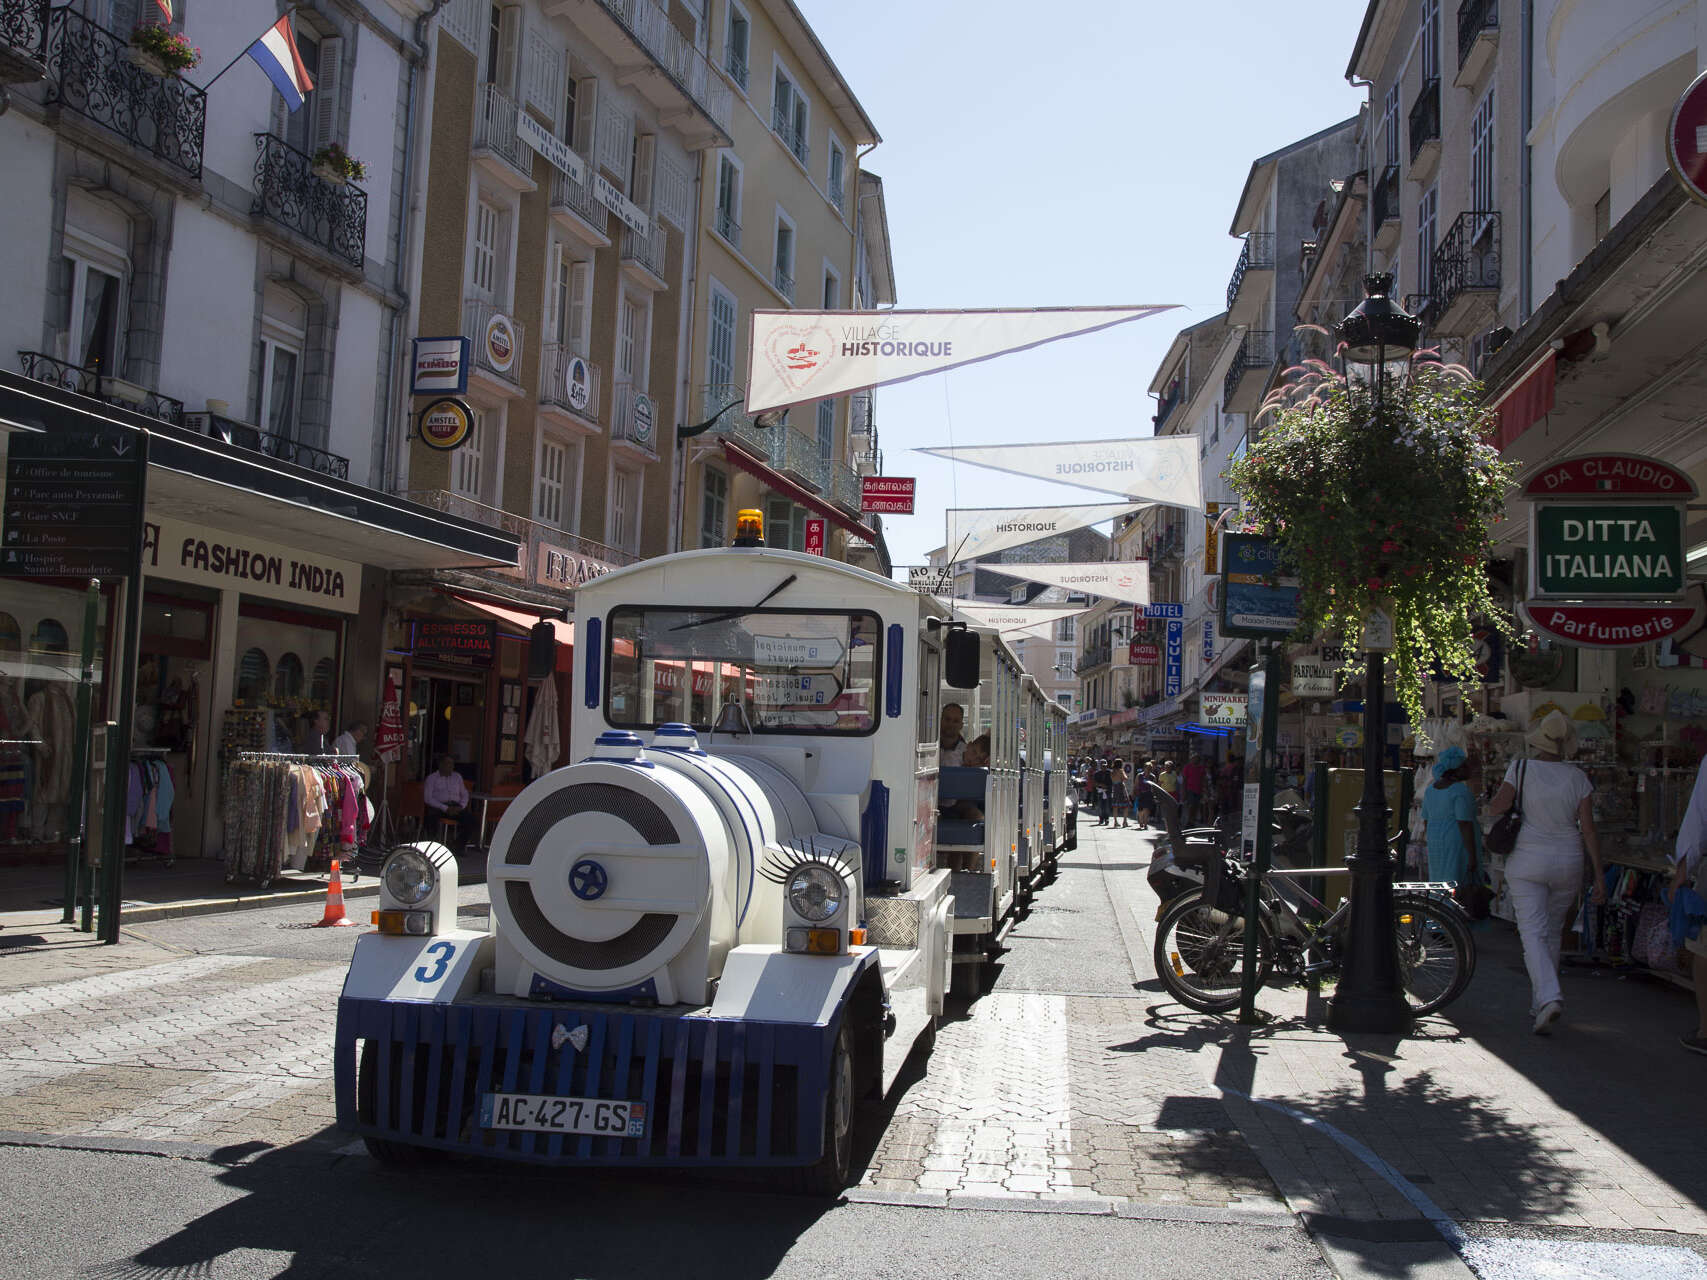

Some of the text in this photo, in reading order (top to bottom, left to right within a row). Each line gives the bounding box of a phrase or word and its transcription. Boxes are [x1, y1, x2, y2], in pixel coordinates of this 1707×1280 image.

[842, 325, 899, 340] VILLAGE
[493, 334, 509, 347] AMSTEL
[842, 342, 952, 357] HISTORIQUE
[418, 361, 458, 369] KIMBO
[571, 383, 586, 404] Leffe
[429, 416, 457, 425] AMSTEL
[30, 465, 55, 477] Office
[60, 467, 71, 477] de
[1544, 461, 1675, 489] DA CLAUDIO
[27, 511, 80, 521] Gare SNCF
[996, 523, 1057, 532] HISTORIQUE
[1563, 520, 1656, 541] DITTA
[43, 534, 66, 544] Poste
[181, 538, 282, 584] FASHION
[289, 561, 344, 598] INDIA
[911, 567, 953, 579] HOEL
[1546, 555, 1673, 578] ITALIANA
[1146, 605, 1180, 617] HOTEL
[1550, 612, 1674, 639] Parfumerie
[1204, 621, 1213, 658] SENG
[1134, 646, 1157, 654] HOTEL
[1169, 637, 1180, 694] JULIEN
[1204, 695, 1249, 704] MINIMARKE
[414, 941, 456, 983] 3
[496, 1097, 628, 1132] AC-427-GS
[628, 1121, 644, 1135] 65
